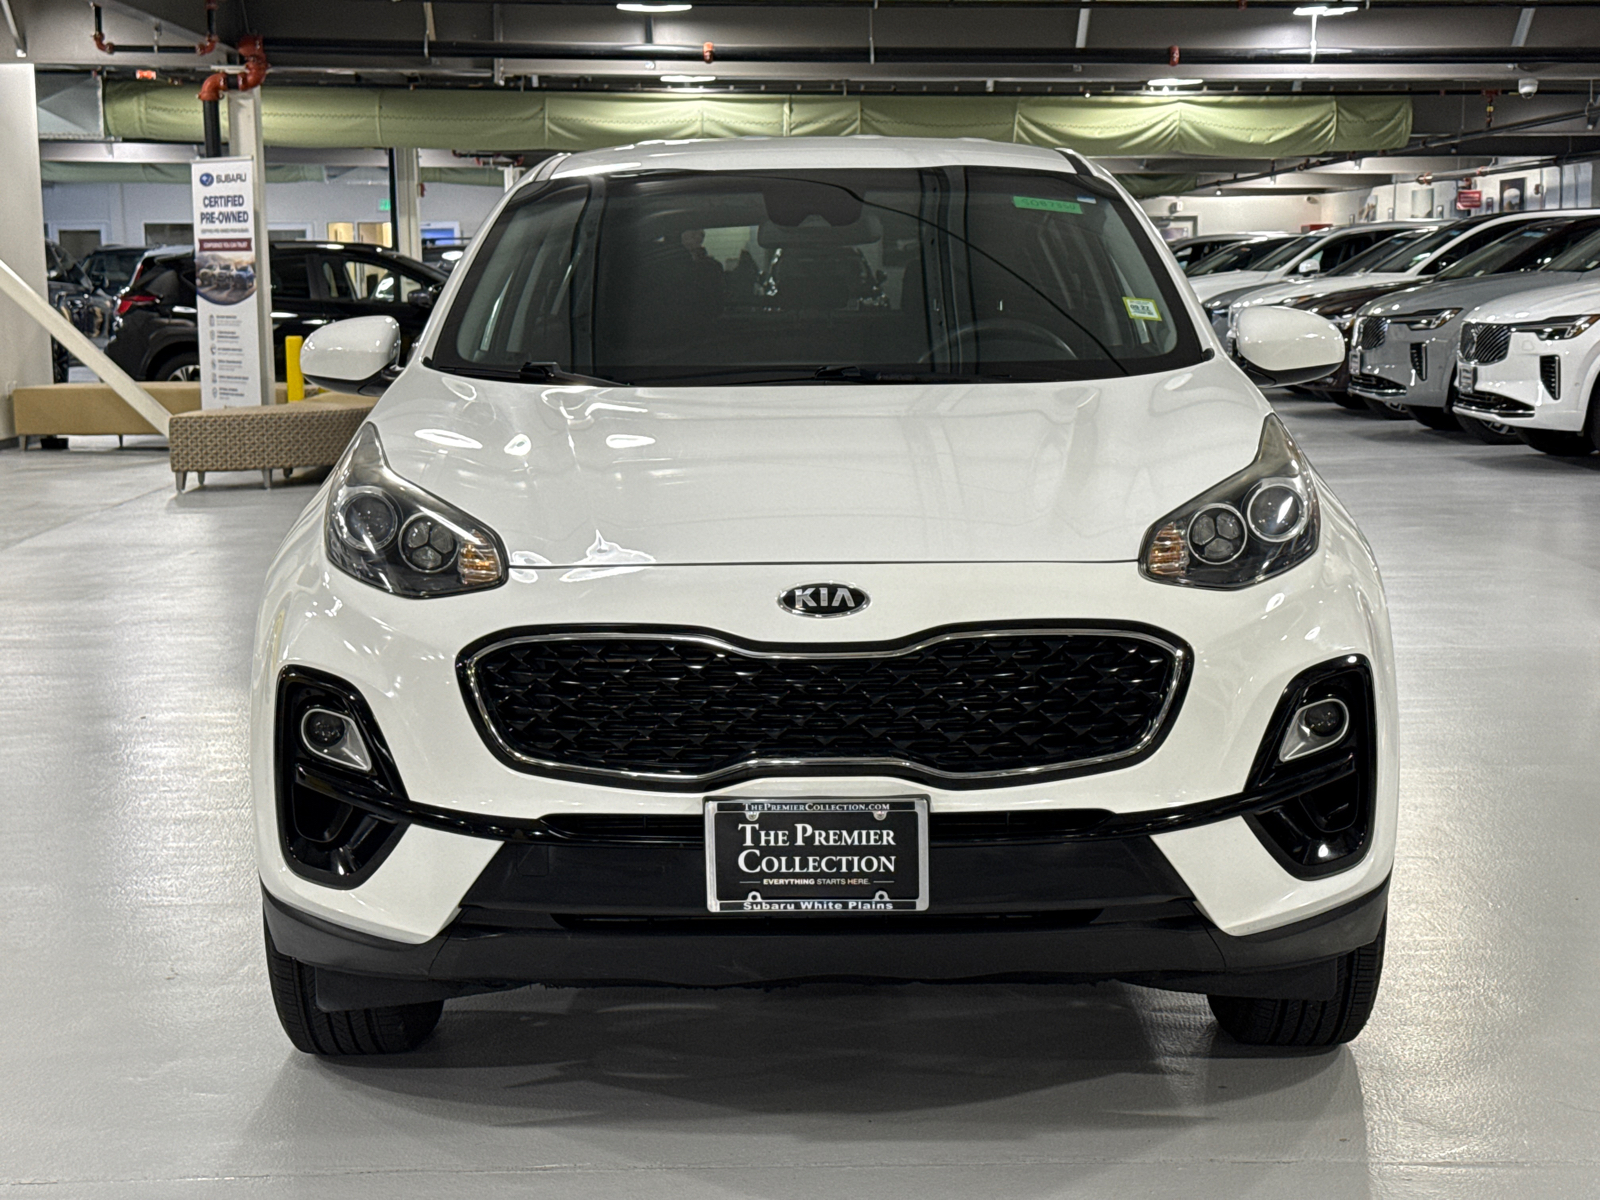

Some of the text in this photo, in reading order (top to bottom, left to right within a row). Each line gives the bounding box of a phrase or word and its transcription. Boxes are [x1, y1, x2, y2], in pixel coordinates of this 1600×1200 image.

[216, 173, 247, 184] SUBARU
[203, 195, 244, 208] CERTIFIED
[200, 211, 249, 224] PRE-OWNED
[794, 587, 856, 608] KIA
[738, 823, 896, 846] THE PREMIER
[738, 849, 896, 873] COLLECTION
[763, 878, 815, 886] EVERYTHING
[743, 901, 894, 911] Subaru White Plains
